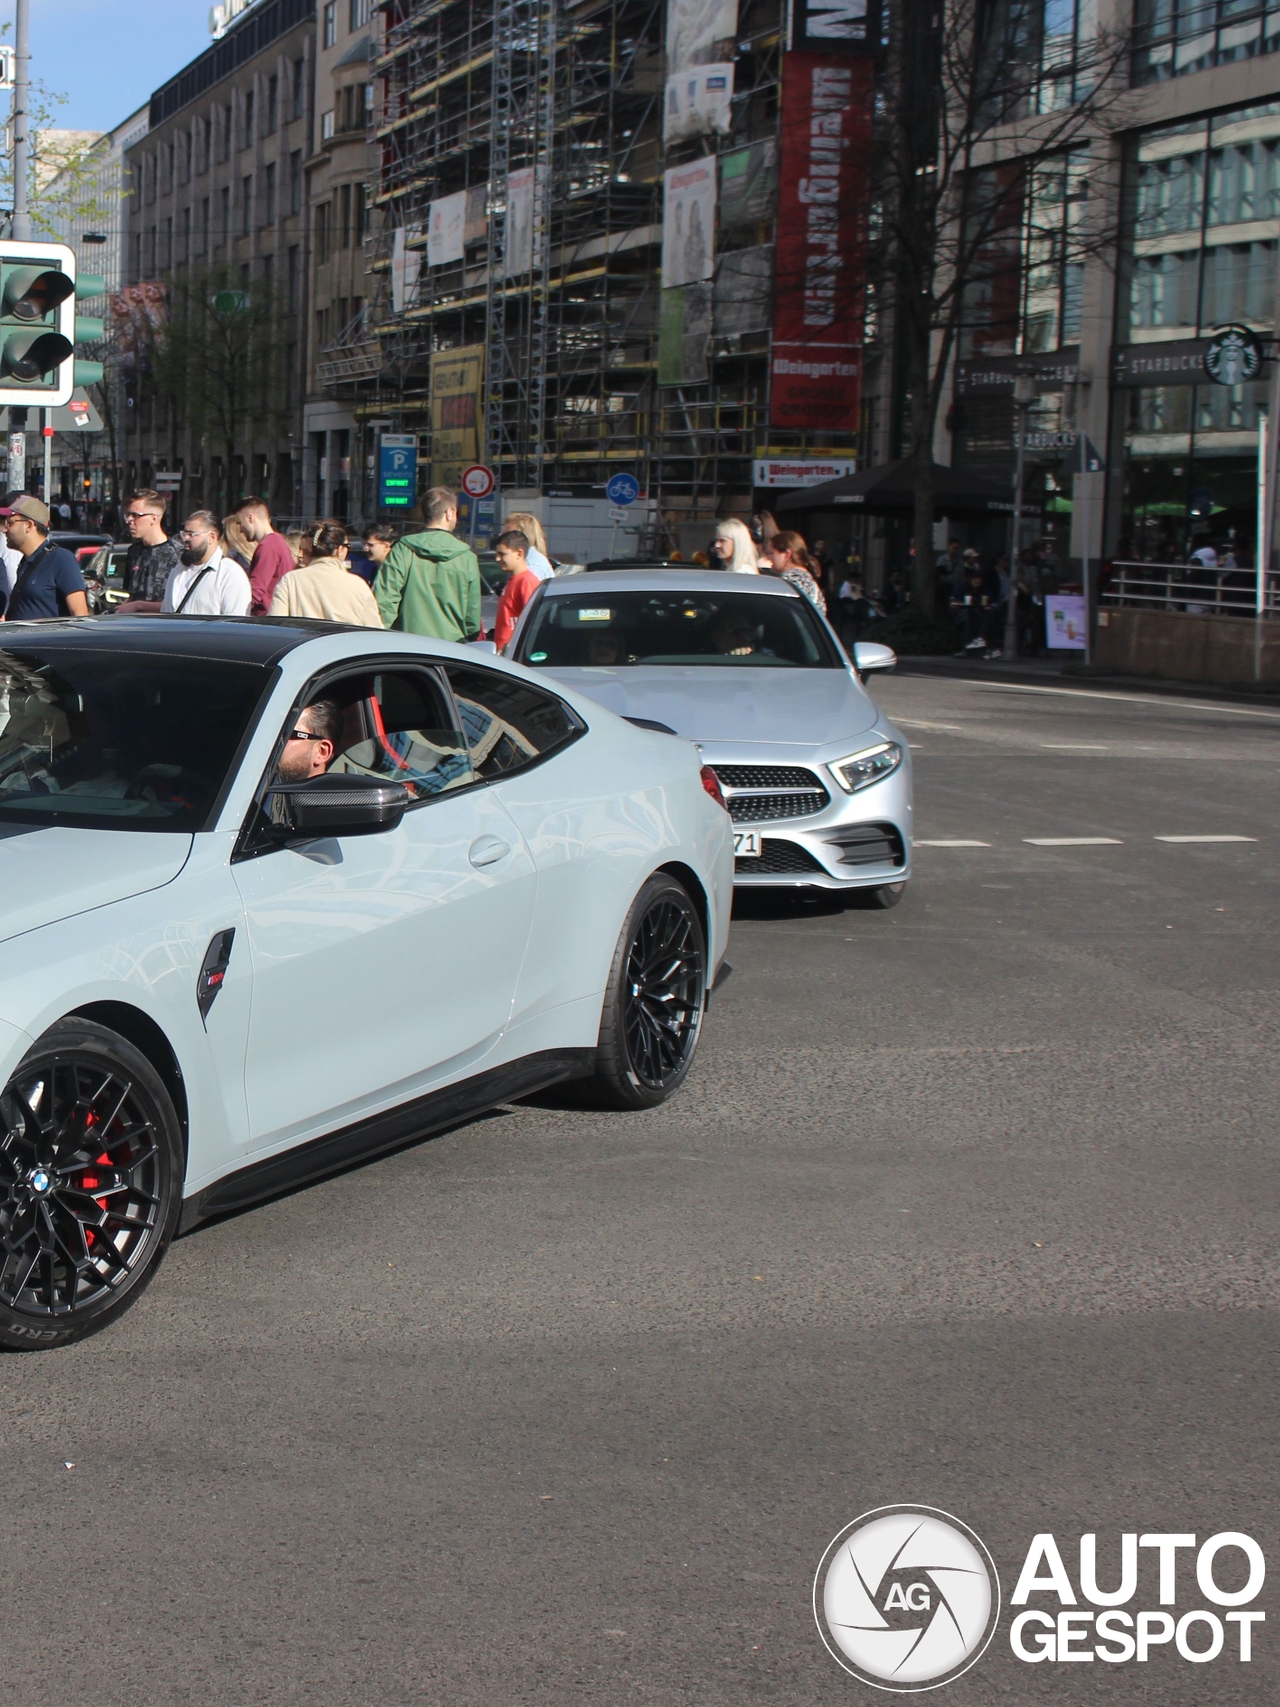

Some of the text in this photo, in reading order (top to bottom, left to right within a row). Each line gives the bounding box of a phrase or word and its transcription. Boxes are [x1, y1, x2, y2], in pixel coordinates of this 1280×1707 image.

[798, 67, 852, 326] Weingarten
[773, 359, 857, 378] Weingarten
[1131, 355, 1204, 374] STARBUCKS
[1013, 431, 1075, 447] SARBUCKS
[769, 464, 834, 478] Weingarten
[734, 833, 757, 853] 71
[7, 1323, 74, 1340] ZERO
